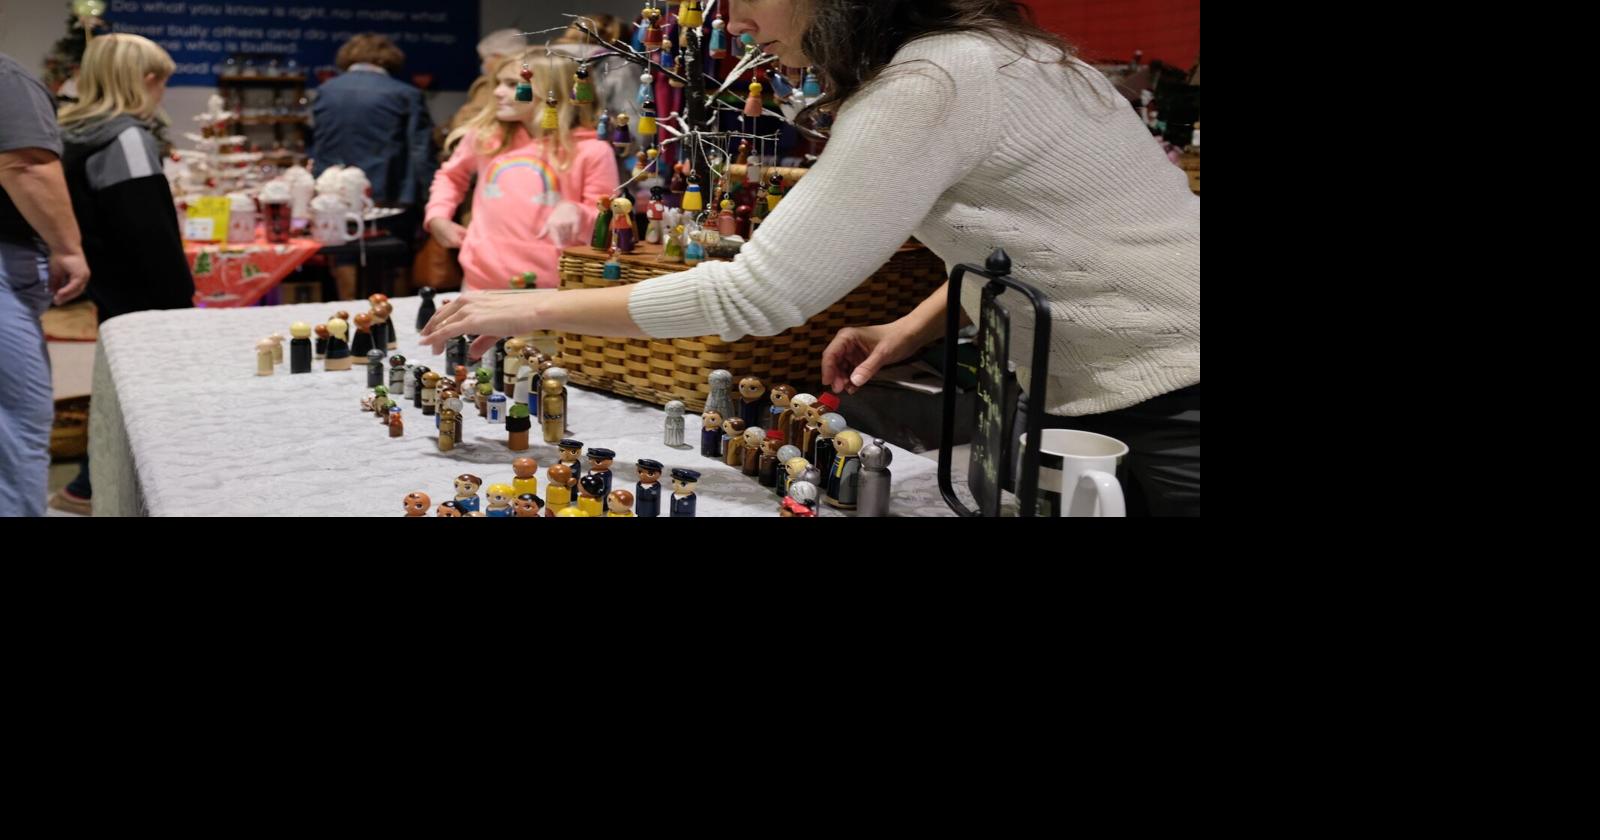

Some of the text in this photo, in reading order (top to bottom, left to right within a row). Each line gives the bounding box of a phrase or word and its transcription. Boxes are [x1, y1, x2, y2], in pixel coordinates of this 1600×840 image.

[111, 1, 139, 13] Do
[143, 1, 186, 14] what
[190, 4, 221, 16] you
[224, 3, 270, 16] know
[273, 6, 285, 17] is
[331, 9, 353, 19] no
[356, 10, 404, 20] matter
[112, 22, 163, 34] Never
[167, 24, 208, 39] bully
[212, 26, 264, 38] others
[267, 28, 302, 40] and
[304, 29, 328, 40] do
[185, 41, 222, 51] who
[225, 42, 238, 52] is
[175, 63, 209, 75] ood
